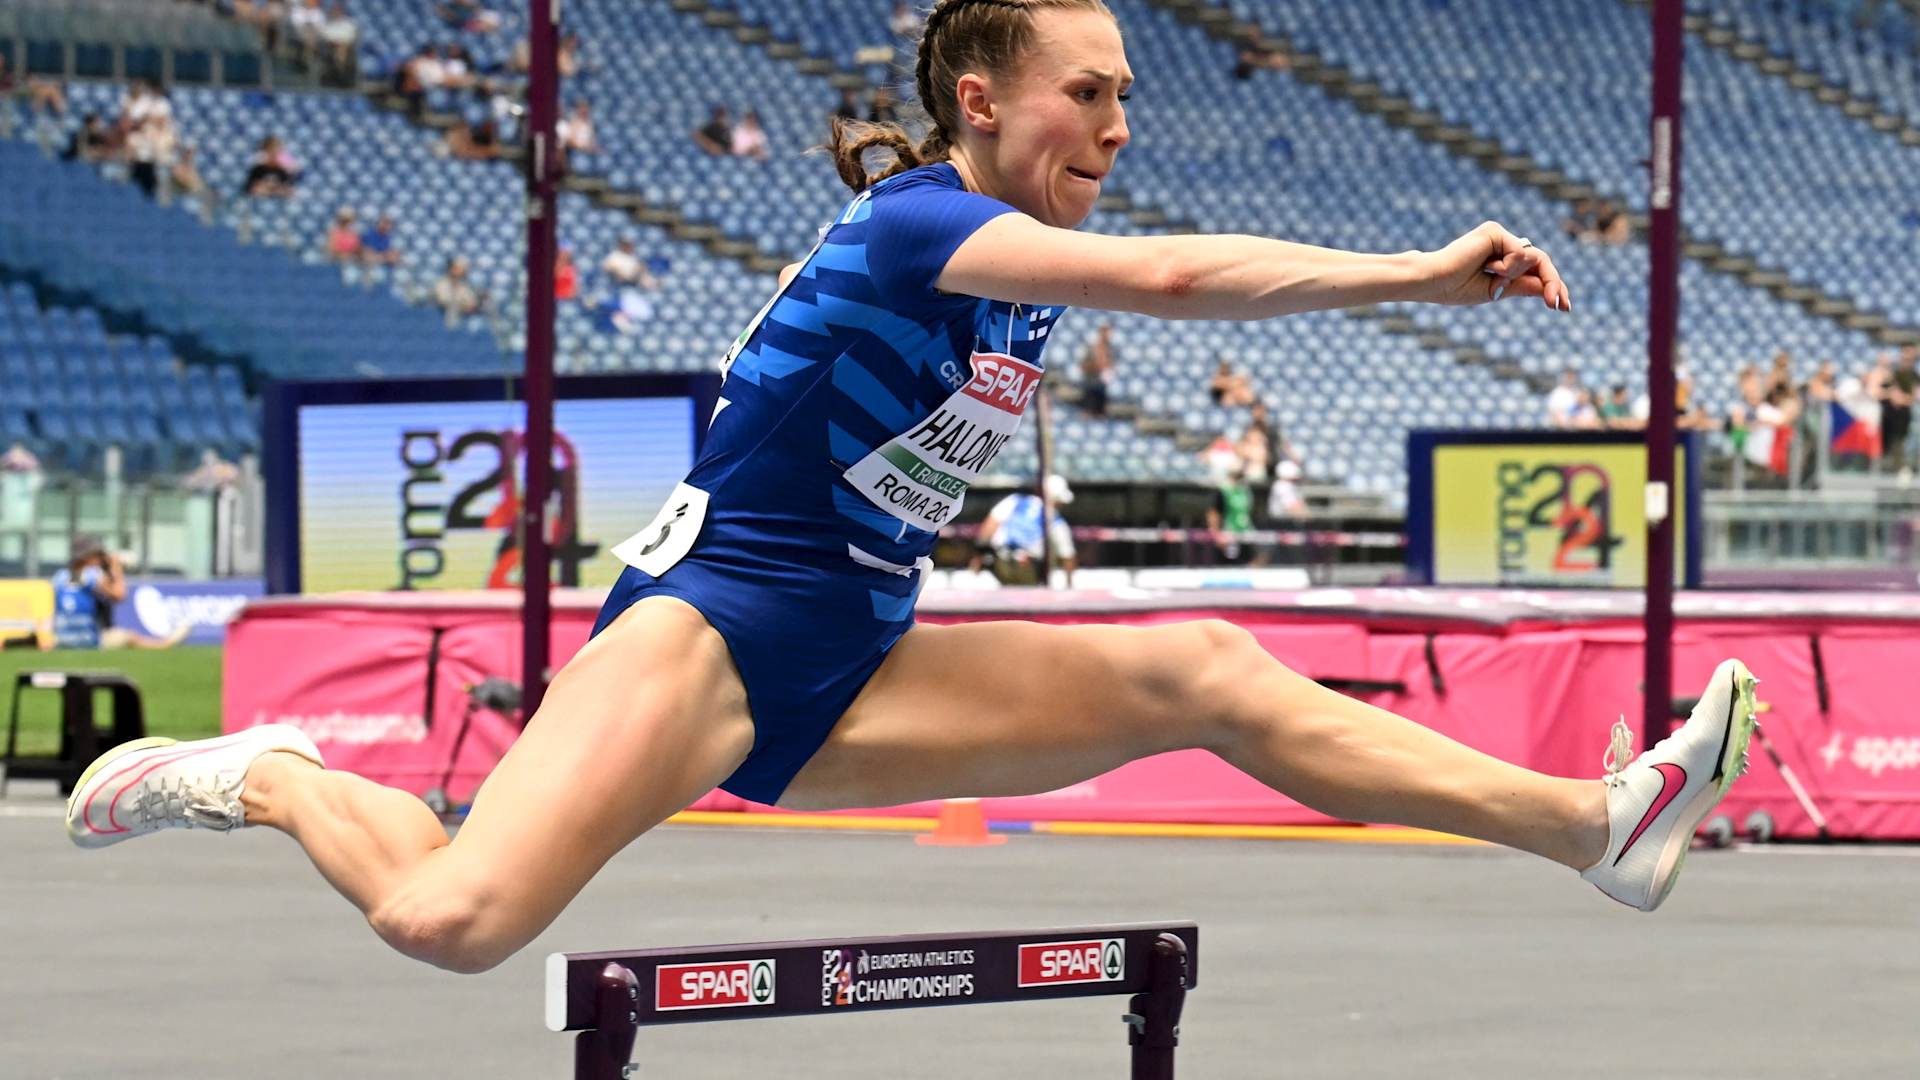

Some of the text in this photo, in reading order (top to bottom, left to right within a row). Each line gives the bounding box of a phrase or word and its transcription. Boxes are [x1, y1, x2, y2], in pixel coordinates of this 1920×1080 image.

[908, 461, 921, 475] I
[914, 466, 942, 487] RUN
[873, 472, 931, 517] ROMA
[870, 950, 975, 970] EUROPEAN ATHLETICS
[1039, 946, 1102, 978] SPAR
[680, 968, 749, 1001] SPAR
[821, 949, 833, 1007] roma
[855, 973, 975, 1003] CHAMPIONSHIPS
